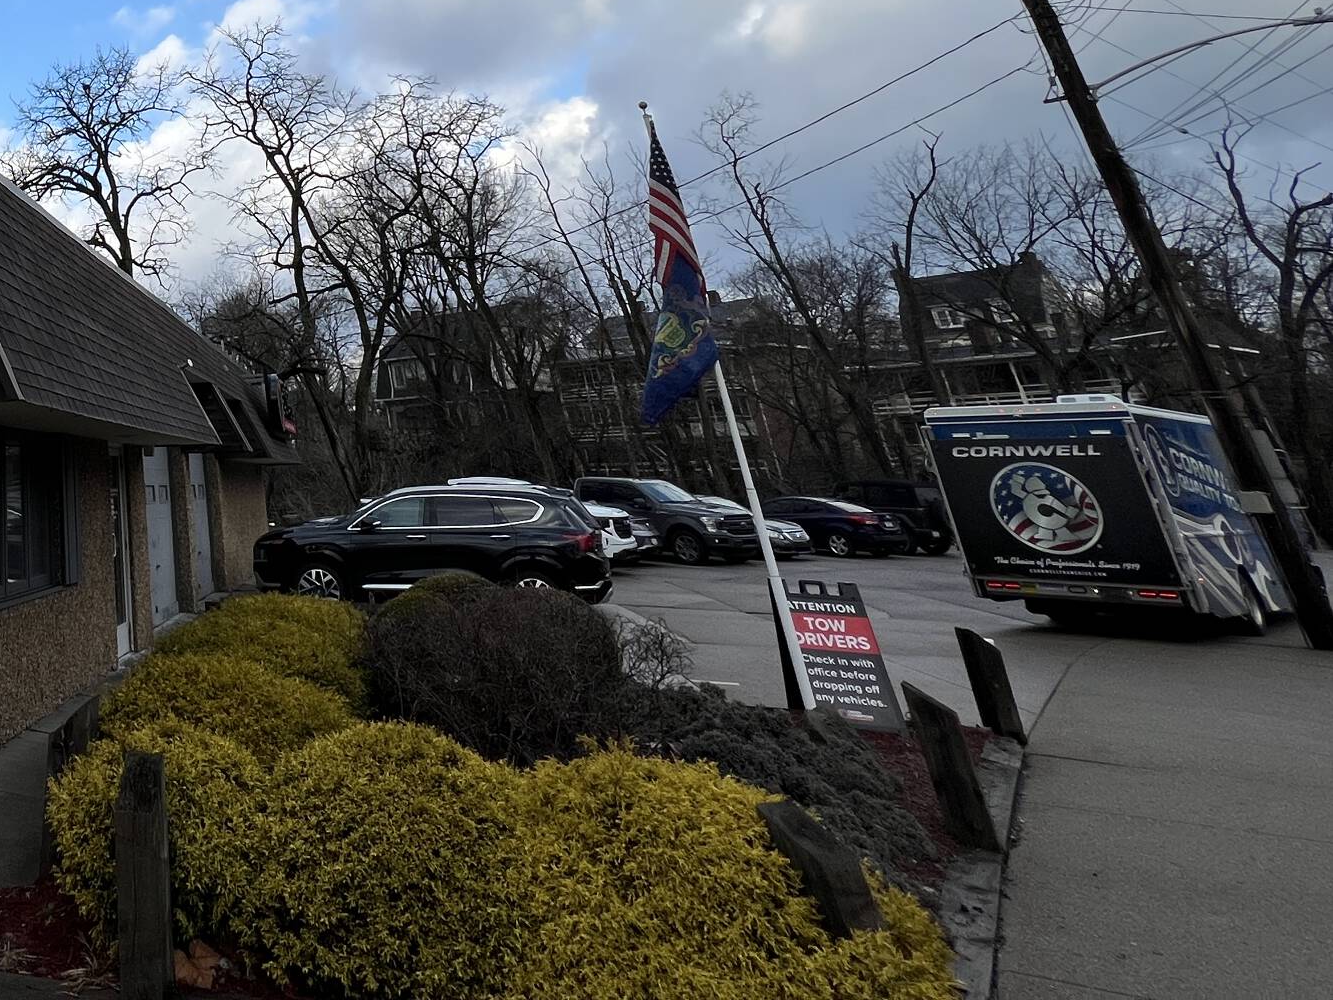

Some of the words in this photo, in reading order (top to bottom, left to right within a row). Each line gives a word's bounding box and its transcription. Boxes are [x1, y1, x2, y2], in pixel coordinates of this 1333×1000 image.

[951, 444, 1102, 458] CORNWELL
[787, 600, 856, 614] ATTENTION
[803, 616, 846, 633] TOW
[795, 631, 871, 650] DRIVERS
[802, 653, 836, 665] Check
[837, 657, 849, 666] in
[850, 658, 875, 669] with
[807, 667, 838, 678] office
[839, 669, 877, 682] before
[812, 679, 863, 695] dropping
[864, 685, 880, 695] off
[815, 693, 835, 705] any
[837, 695, 888, 708] vehicles.
